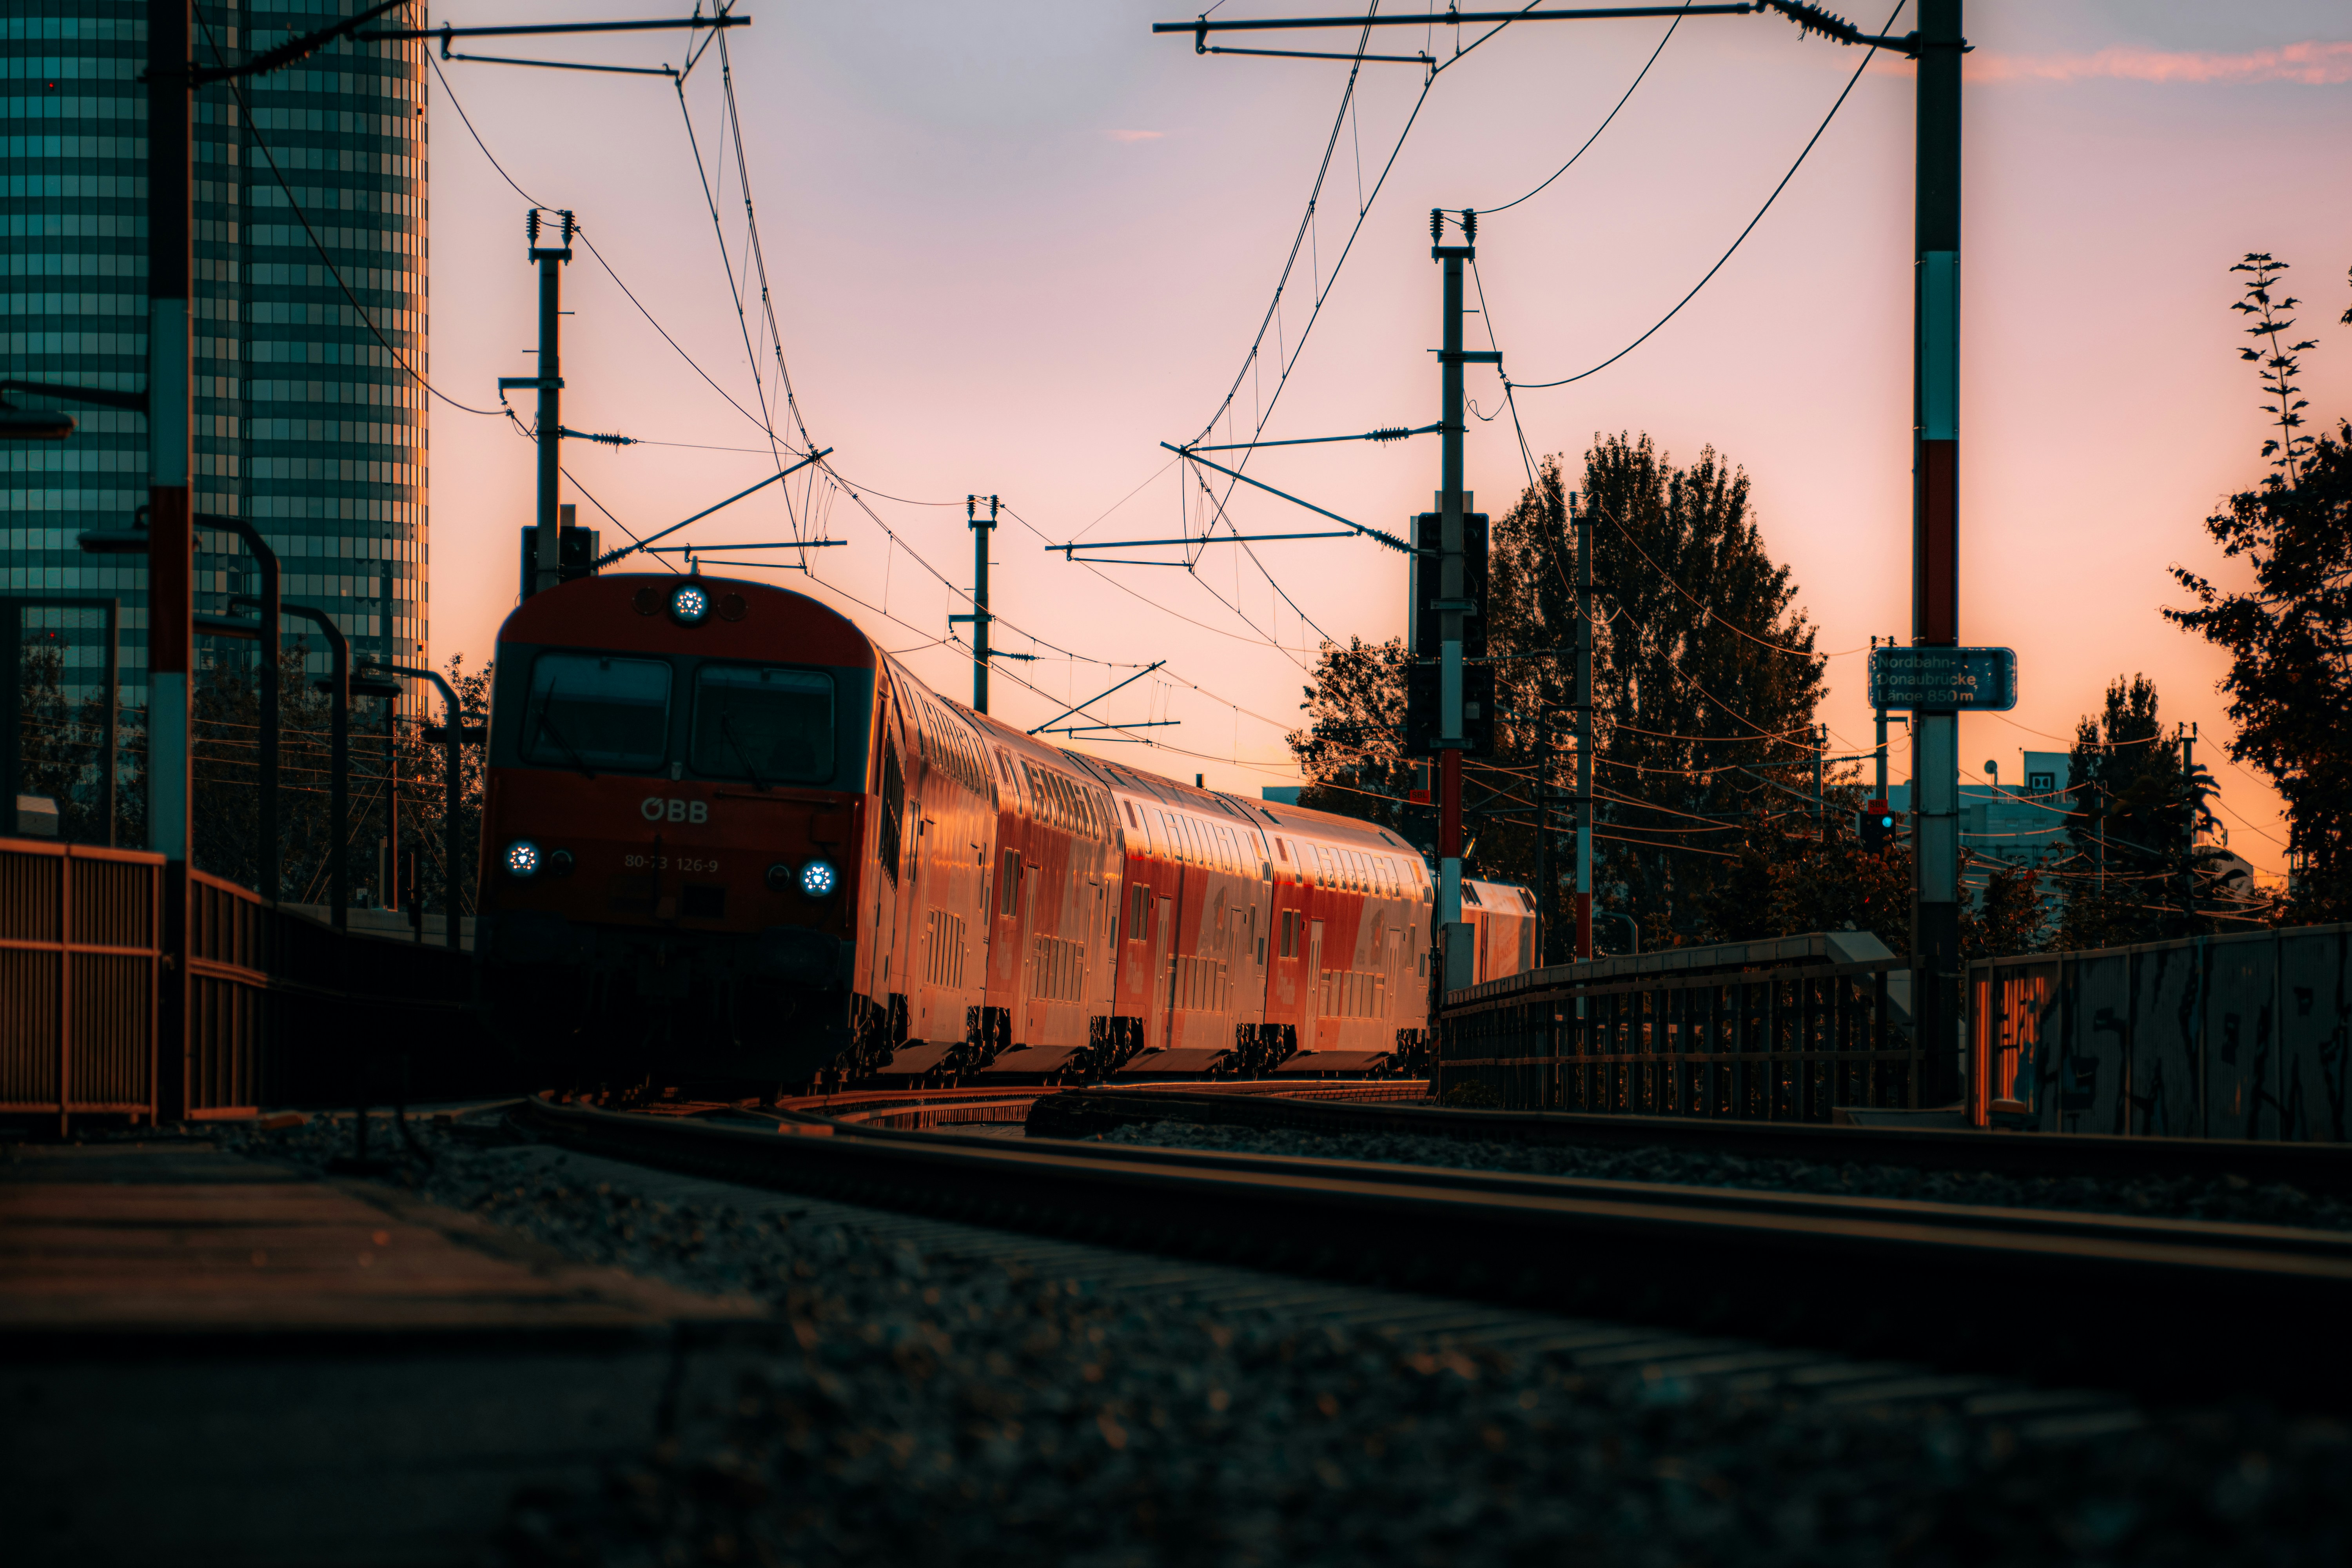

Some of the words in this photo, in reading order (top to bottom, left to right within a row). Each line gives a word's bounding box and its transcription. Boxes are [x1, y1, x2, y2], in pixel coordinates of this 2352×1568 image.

[1878, 656, 1956, 668] Nordbahn-
[1878, 672, 1976, 686] Donaubrücke
[1878, 690, 1923, 704] Länge
[1927, 690, 1957, 702] 850
[1960, 691, 1974, 702] m
[641, 797, 708, 824] ÖBB
[676, 858, 718, 872] 126-9
